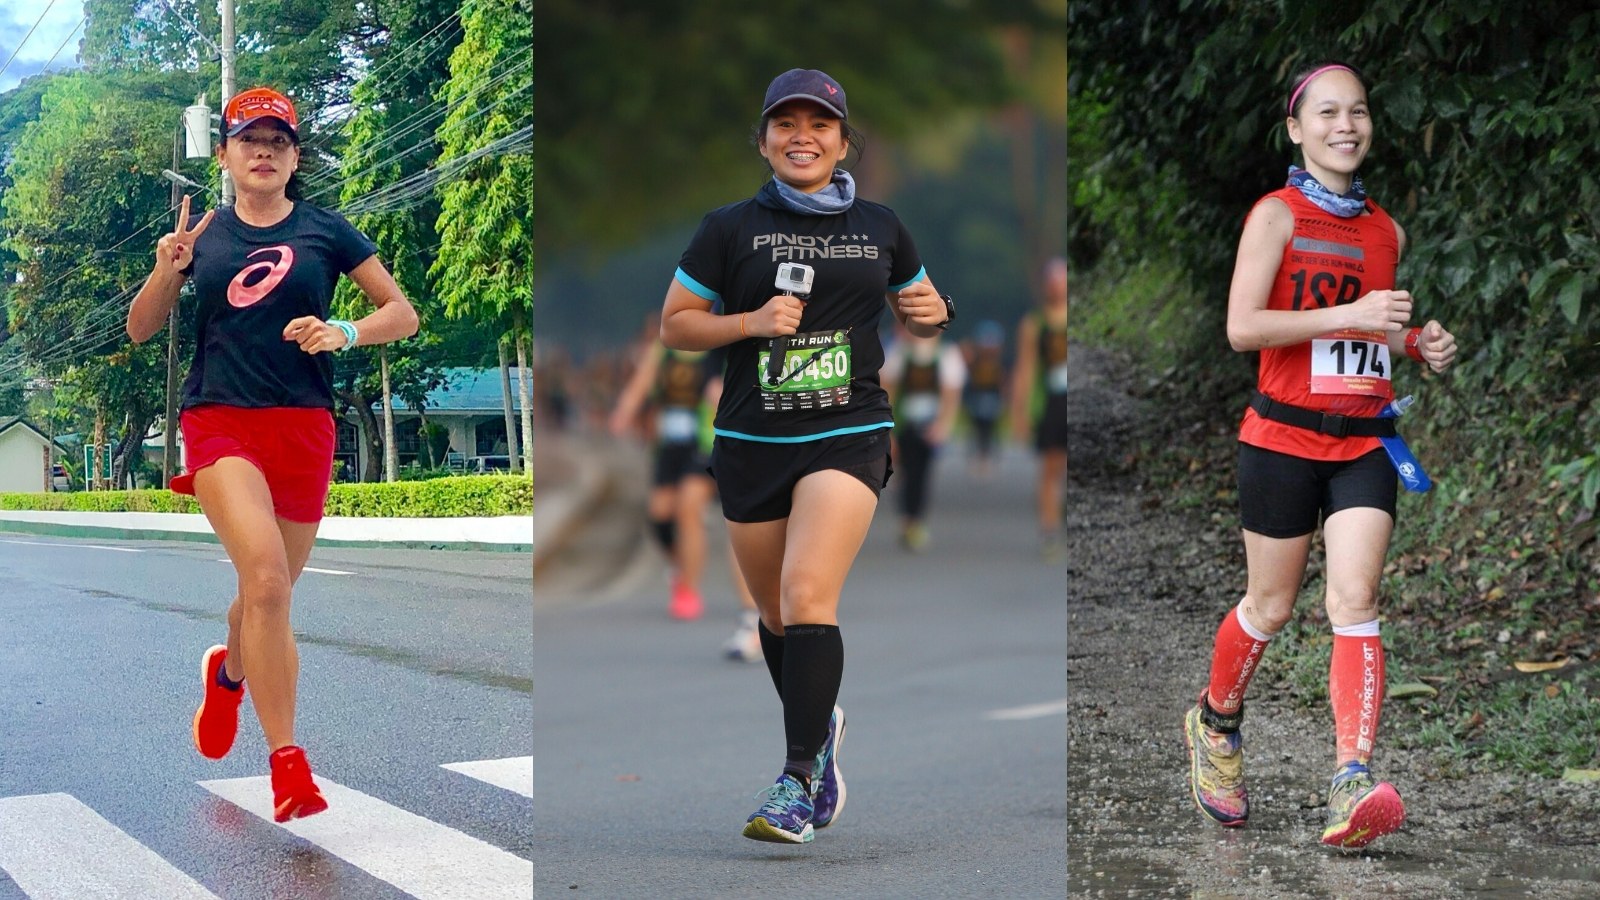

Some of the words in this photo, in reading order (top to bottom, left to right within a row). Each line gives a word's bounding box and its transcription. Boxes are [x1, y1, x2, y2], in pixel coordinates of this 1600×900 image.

[753, 233, 835, 250] PINOY
[772, 245, 879, 262] FITNESS
[769, 338, 805, 347] ETH
[809, 335, 832, 345] RUN
[1330, 341, 1384, 378] 174
